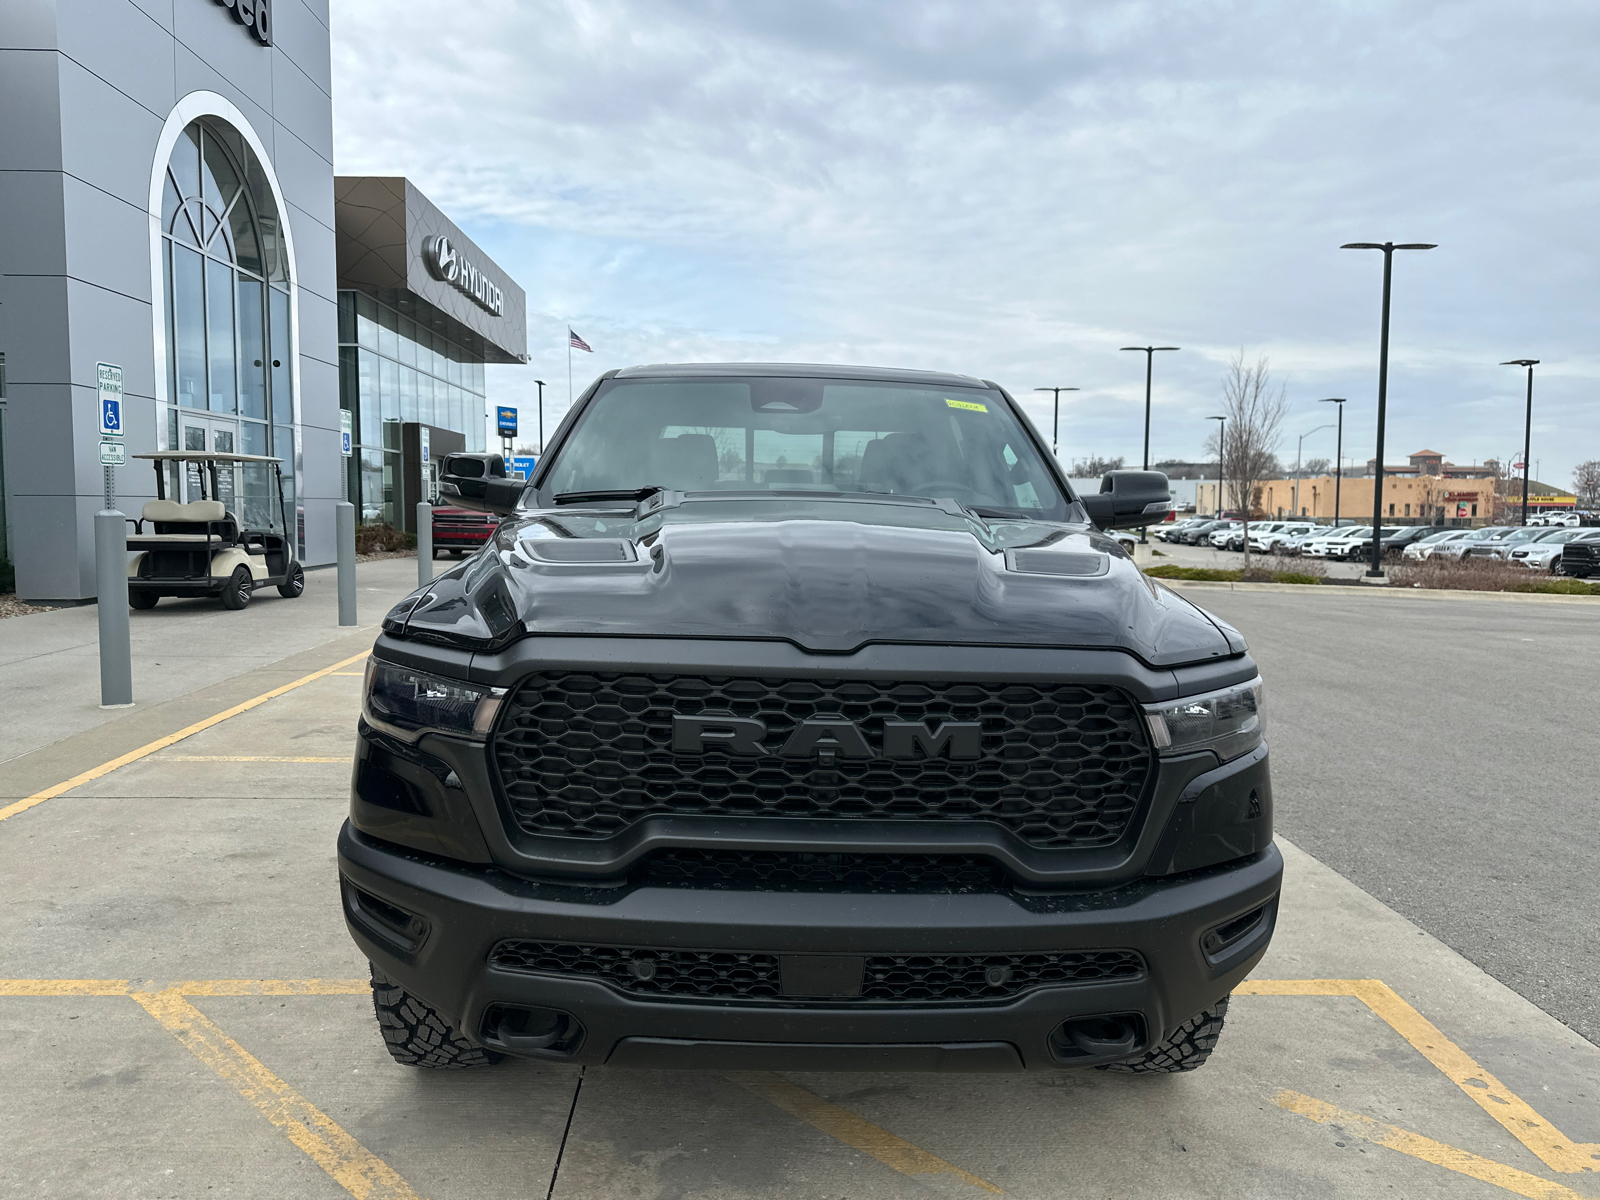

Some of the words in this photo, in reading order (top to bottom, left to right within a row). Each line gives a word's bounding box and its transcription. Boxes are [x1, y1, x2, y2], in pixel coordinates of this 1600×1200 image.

[222, 0, 273, 47] ed
[461, 256, 503, 317] HYUNDAI
[100, 369, 121, 382] RESERVED
[100, 382, 121, 394] PARKING
[102, 454, 124, 462] ACCESSIBLE
[672, 714, 982, 758] RAM
